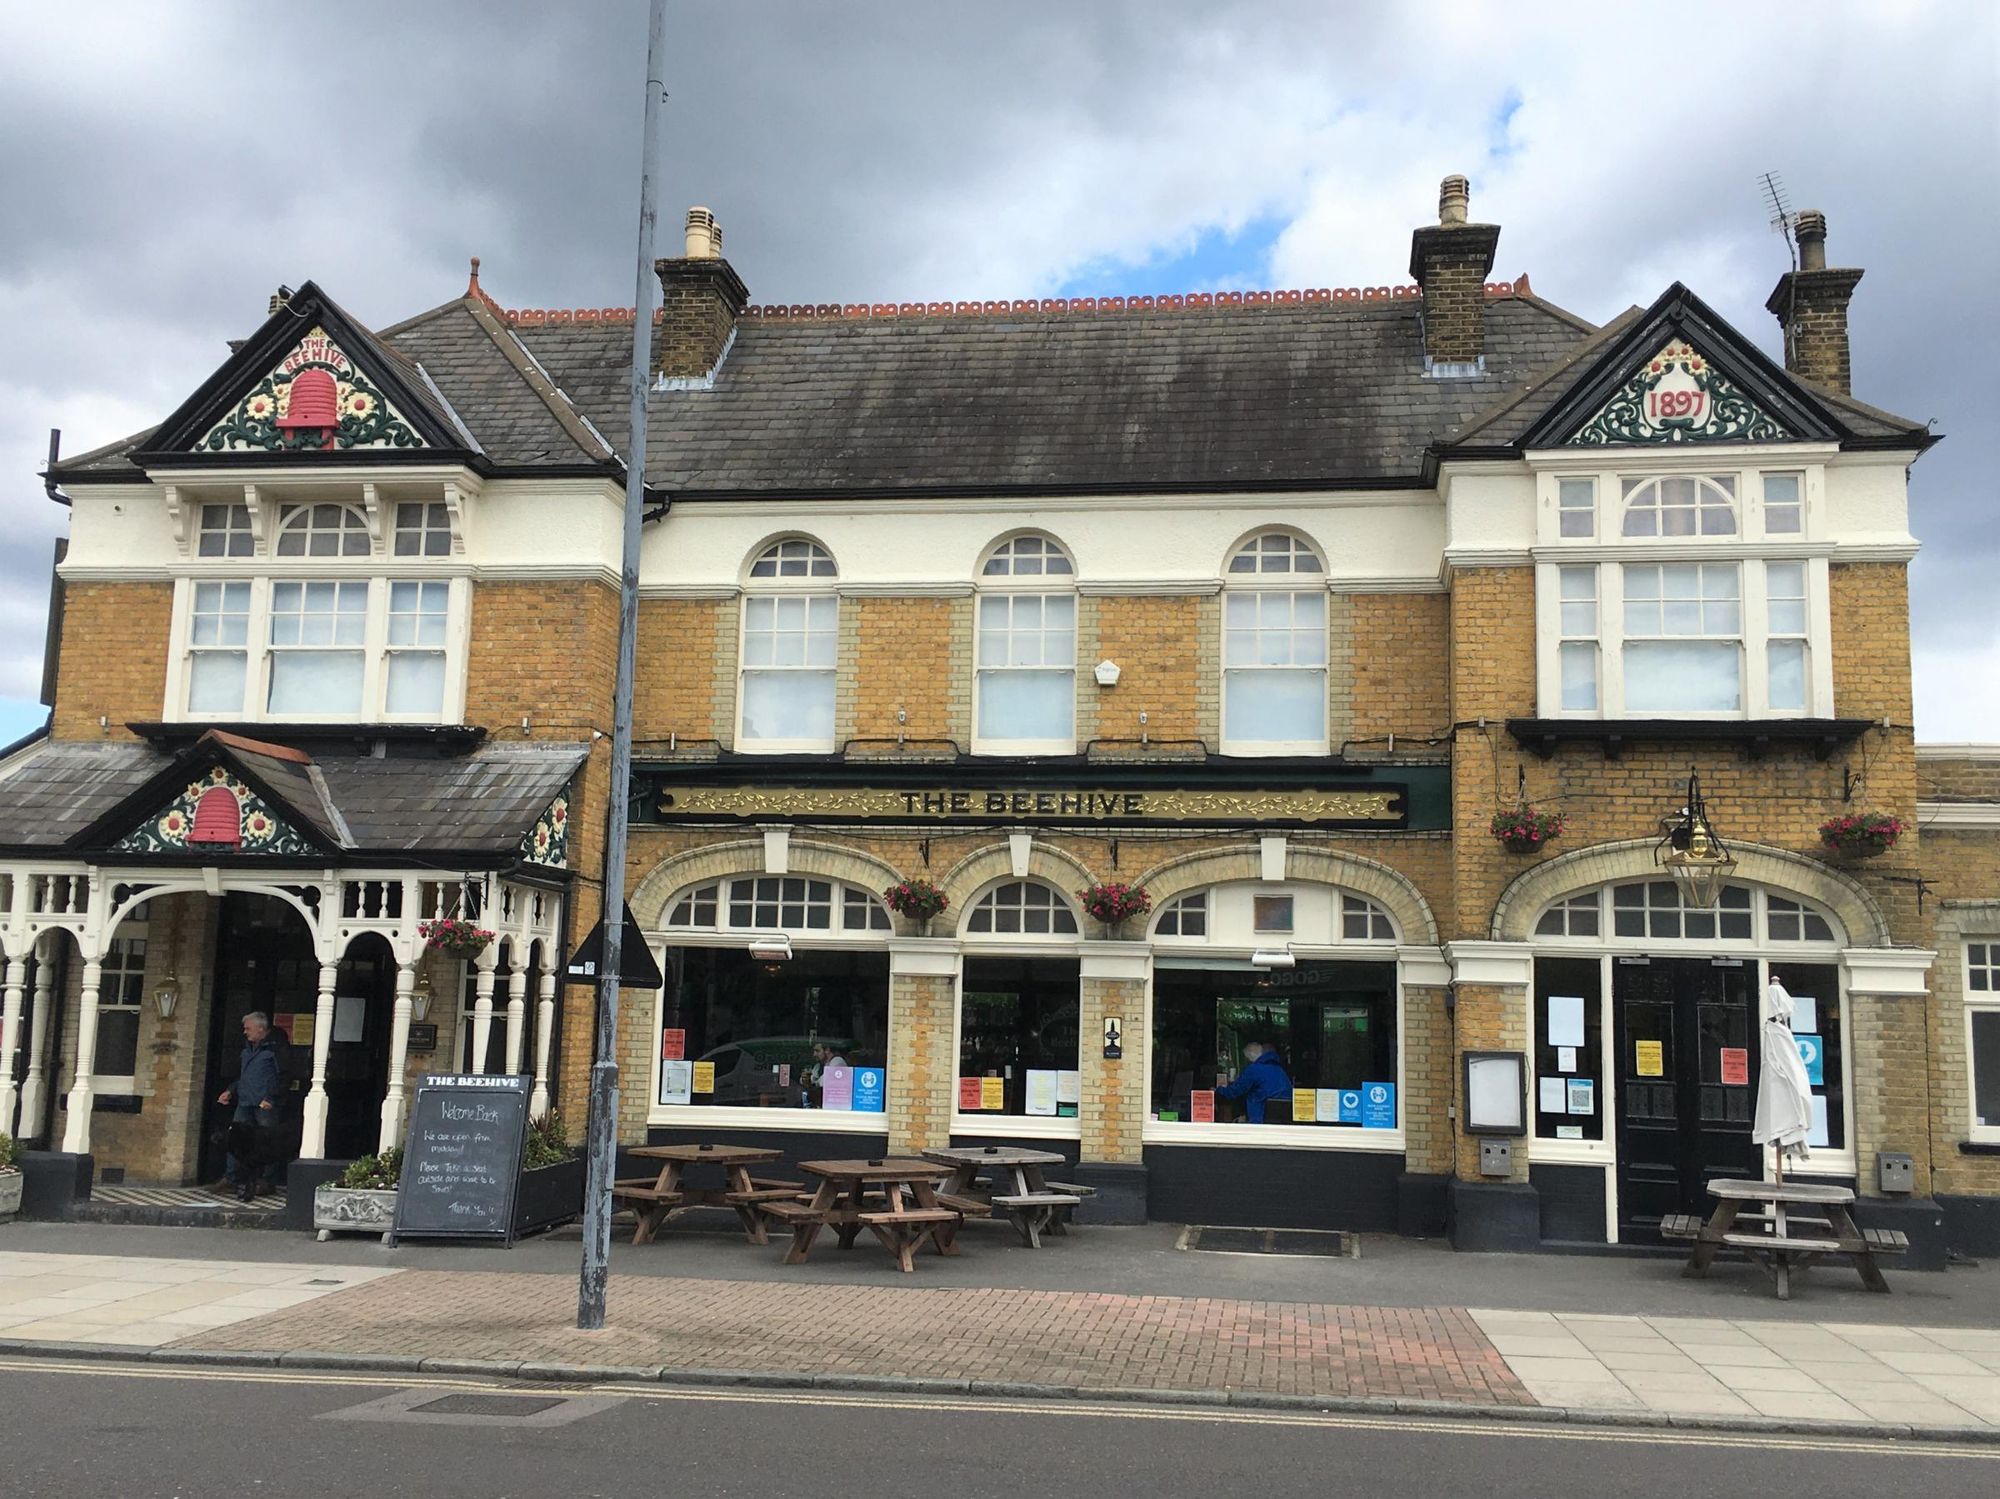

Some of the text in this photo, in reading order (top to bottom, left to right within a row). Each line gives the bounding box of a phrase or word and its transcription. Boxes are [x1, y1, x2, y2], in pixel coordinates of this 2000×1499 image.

[303, 339, 325, 349] THE
[284, 348, 346, 372] BEEHIVE
[1650, 391, 1705, 418] 1897
[900, 792, 1143, 815] THE BEEHIVE
[426, 1076, 520, 1088] THE BEEHIVE
[441, 1101, 474, 1121] Welcome
